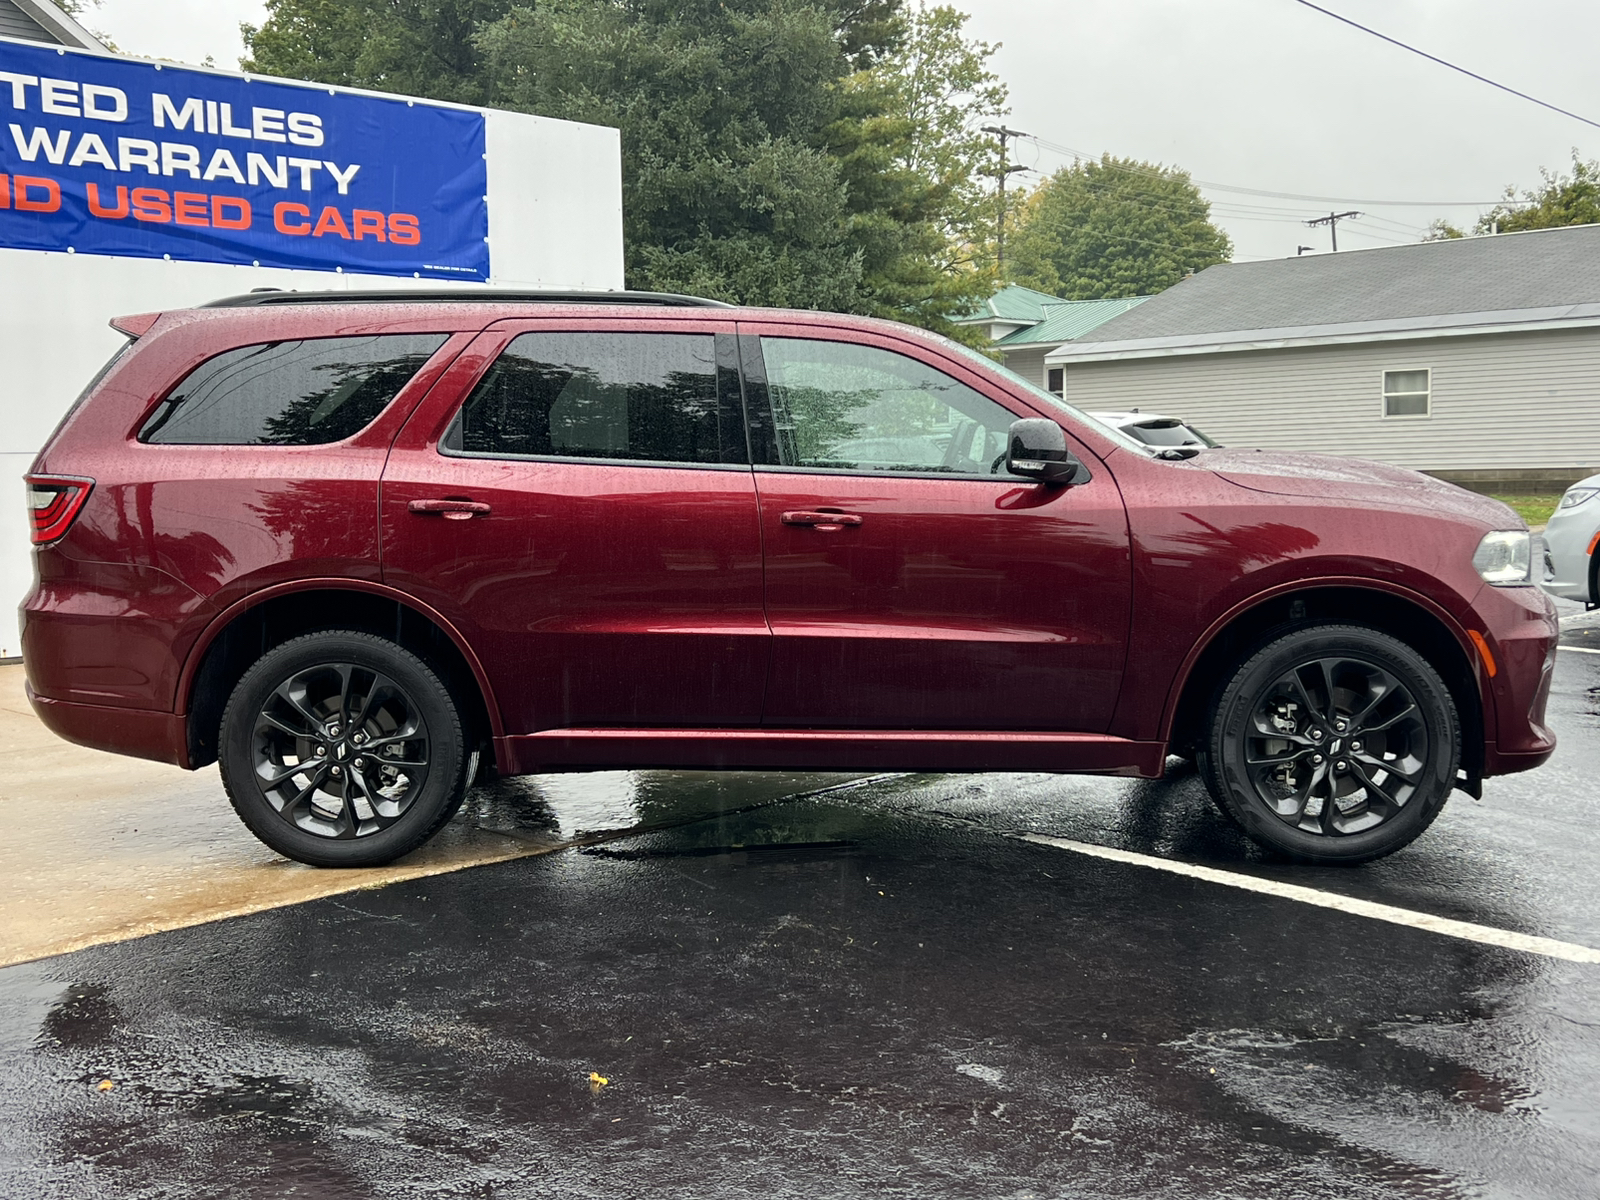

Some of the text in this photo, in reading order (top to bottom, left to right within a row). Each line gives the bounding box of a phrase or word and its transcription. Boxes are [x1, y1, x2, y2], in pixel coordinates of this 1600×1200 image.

[0, 71, 325, 147] TED MILES
[8, 123, 361, 195] WARRANTY
[0, 173, 421, 245] D USED CARS
